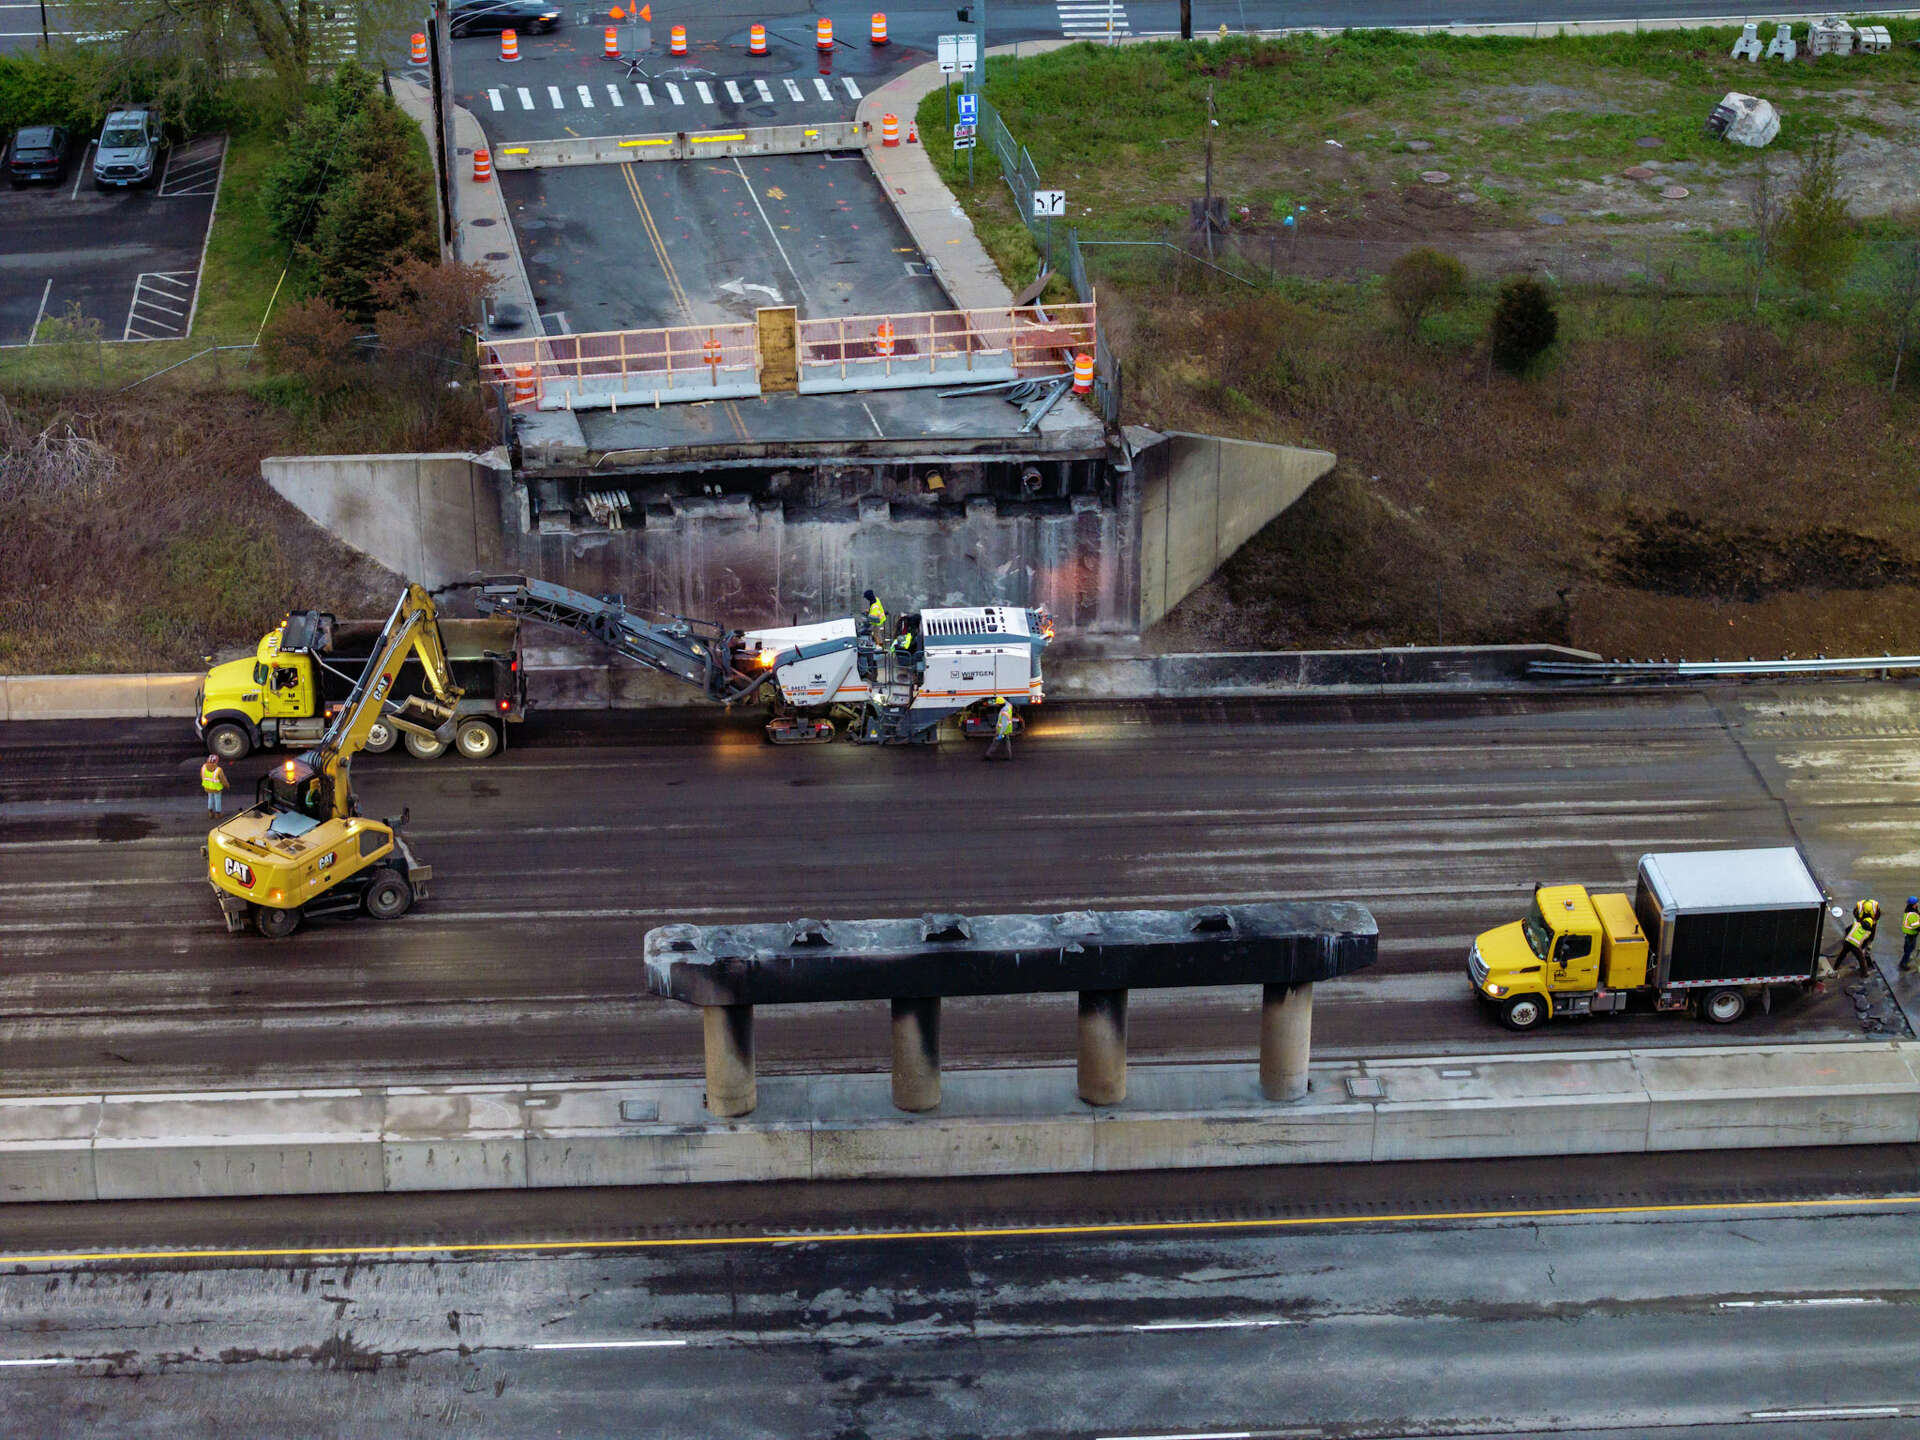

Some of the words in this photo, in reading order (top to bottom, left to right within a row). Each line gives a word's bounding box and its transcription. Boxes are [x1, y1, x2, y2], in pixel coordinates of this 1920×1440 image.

[961, 96, 975, 113] H
[373, 676, 389, 701] CAT
[225, 857, 249, 883] CAT
[318, 852, 334, 870] CAT
